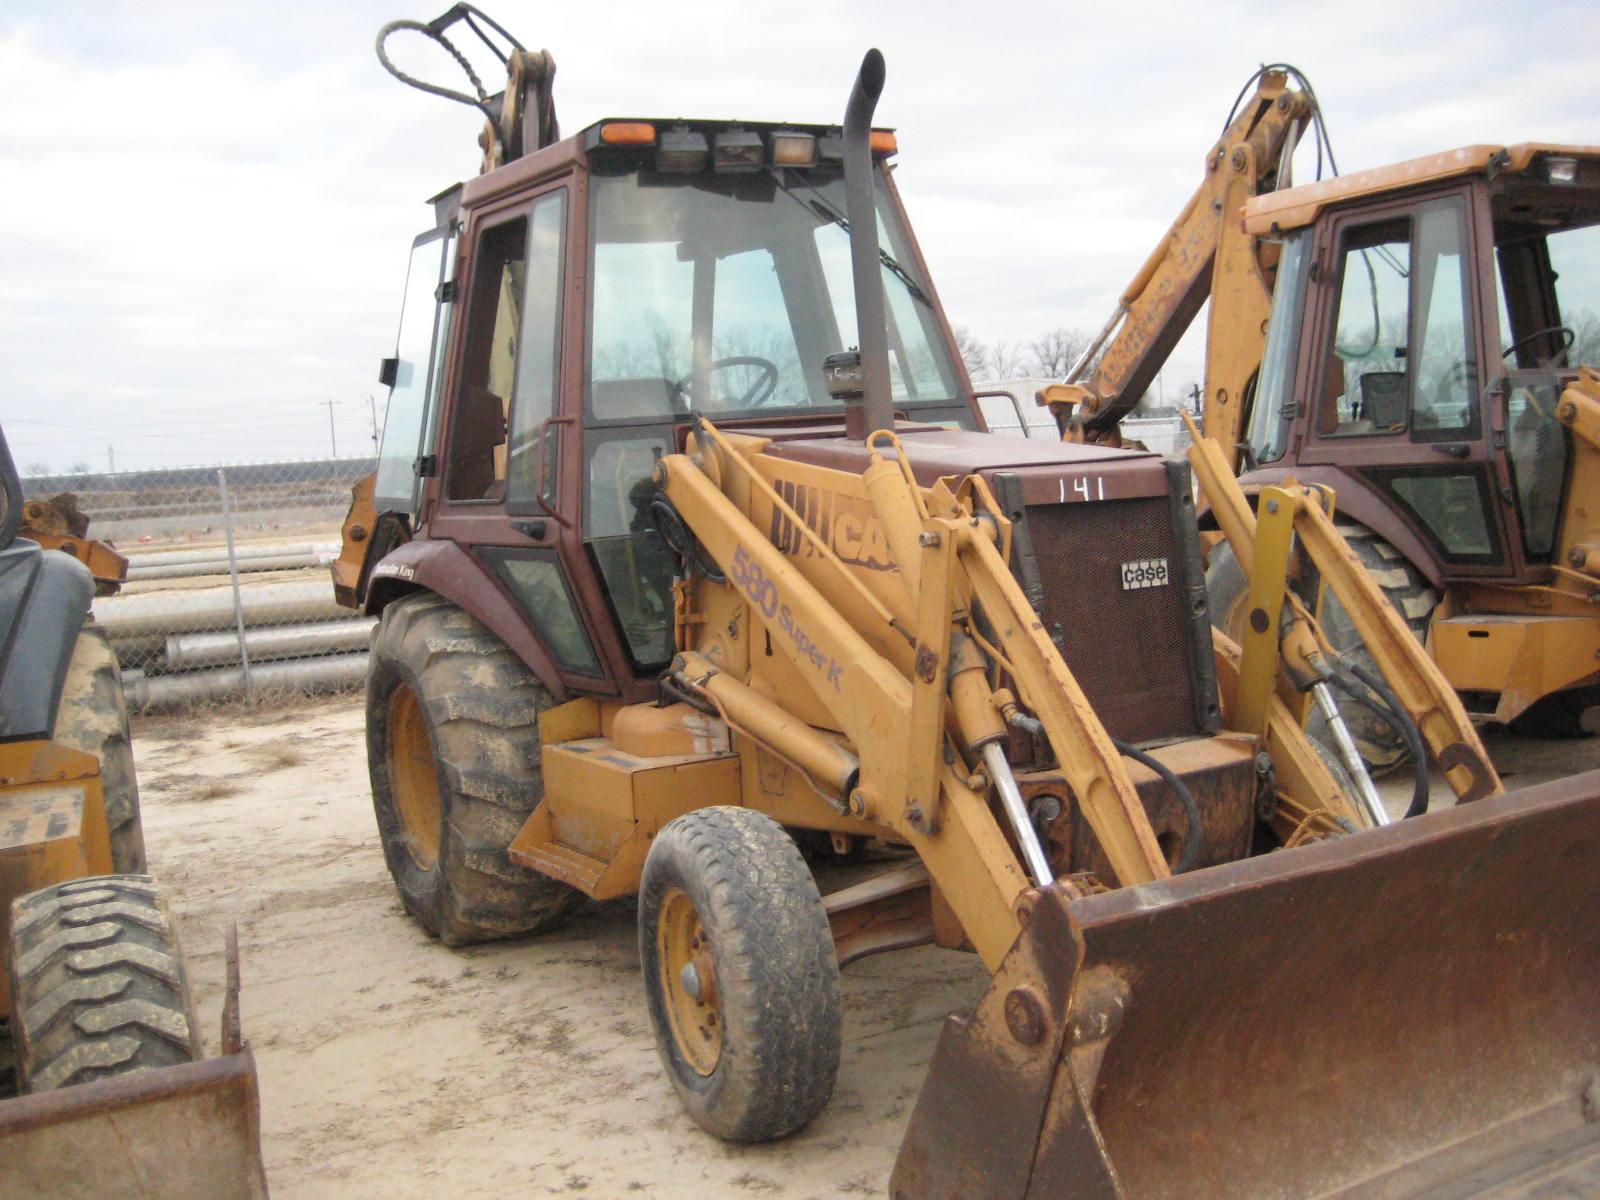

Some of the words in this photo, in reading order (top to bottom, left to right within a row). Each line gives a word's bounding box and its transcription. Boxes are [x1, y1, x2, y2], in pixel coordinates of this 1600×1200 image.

[1059, 477, 1104, 503] 141
[833, 512, 891, 569] CA
[732, 544, 778, 618] 580
